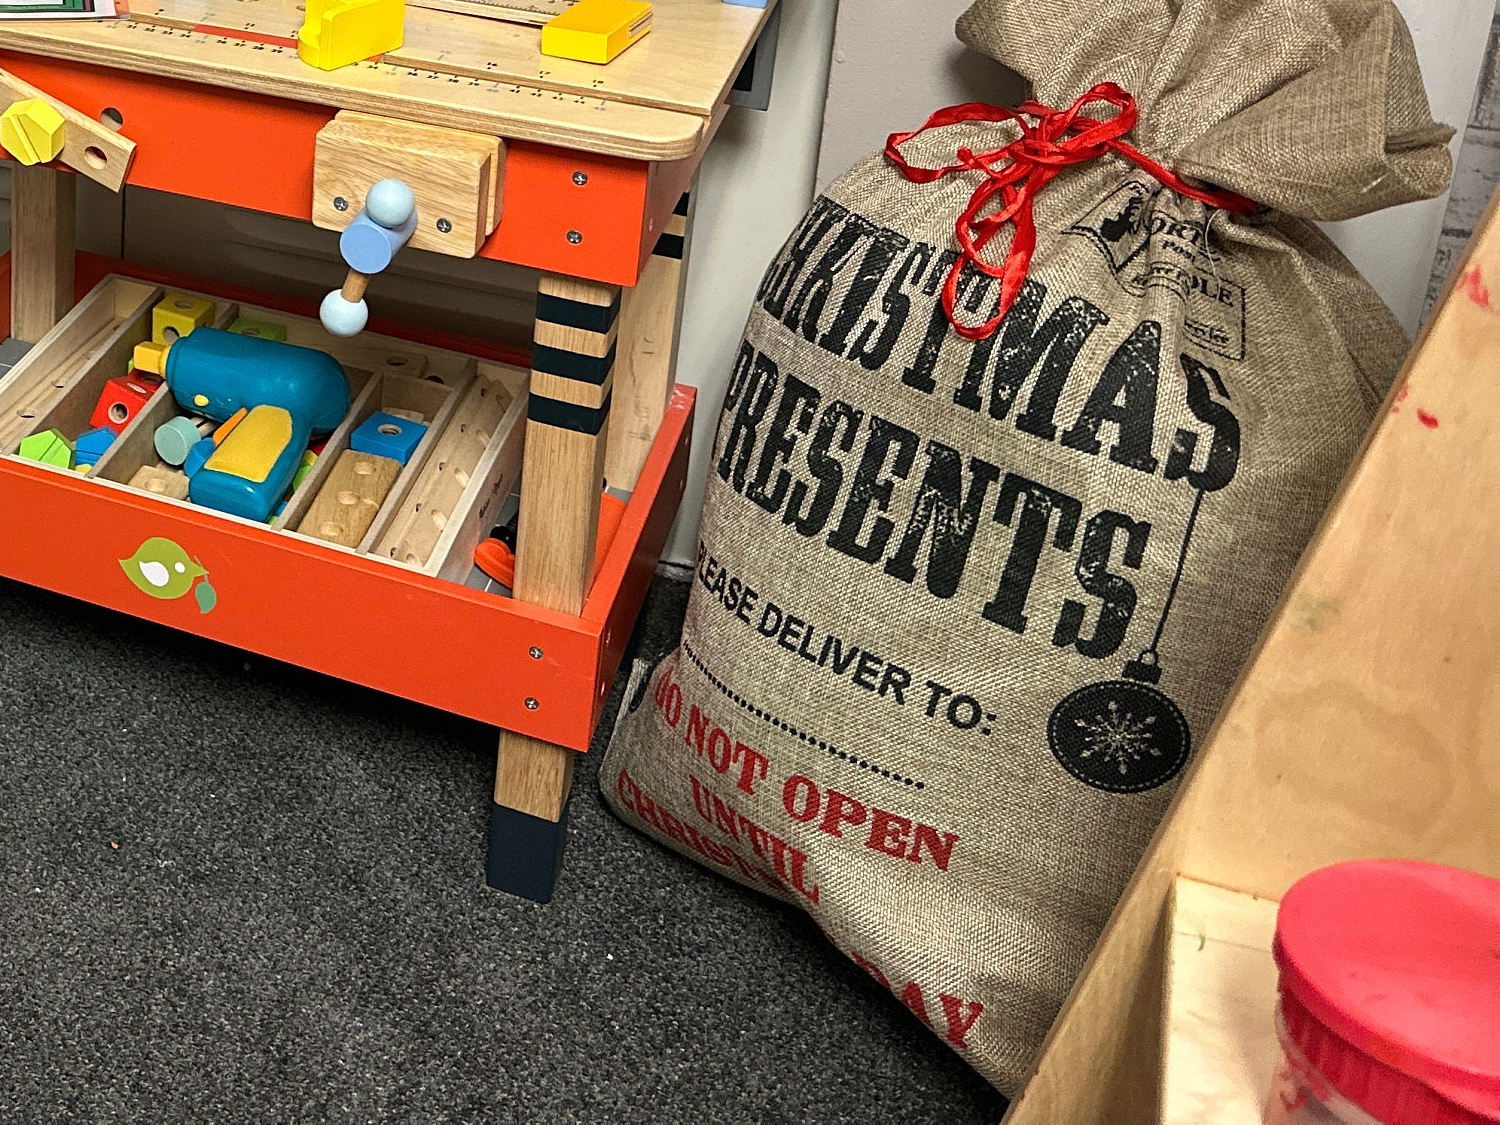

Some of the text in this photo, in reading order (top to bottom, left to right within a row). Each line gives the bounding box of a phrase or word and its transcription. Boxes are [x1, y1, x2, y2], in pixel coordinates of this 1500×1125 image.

[711, 340, 1152, 659] PRESENTS
[757, 602, 912, 706] DELIVER
[924, 680, 998, 736] TO:
[684, 704, 770, 796] NOT
[782, 774, 961, 872] OPEN
[689, 775, 820, 905] UNTIL
